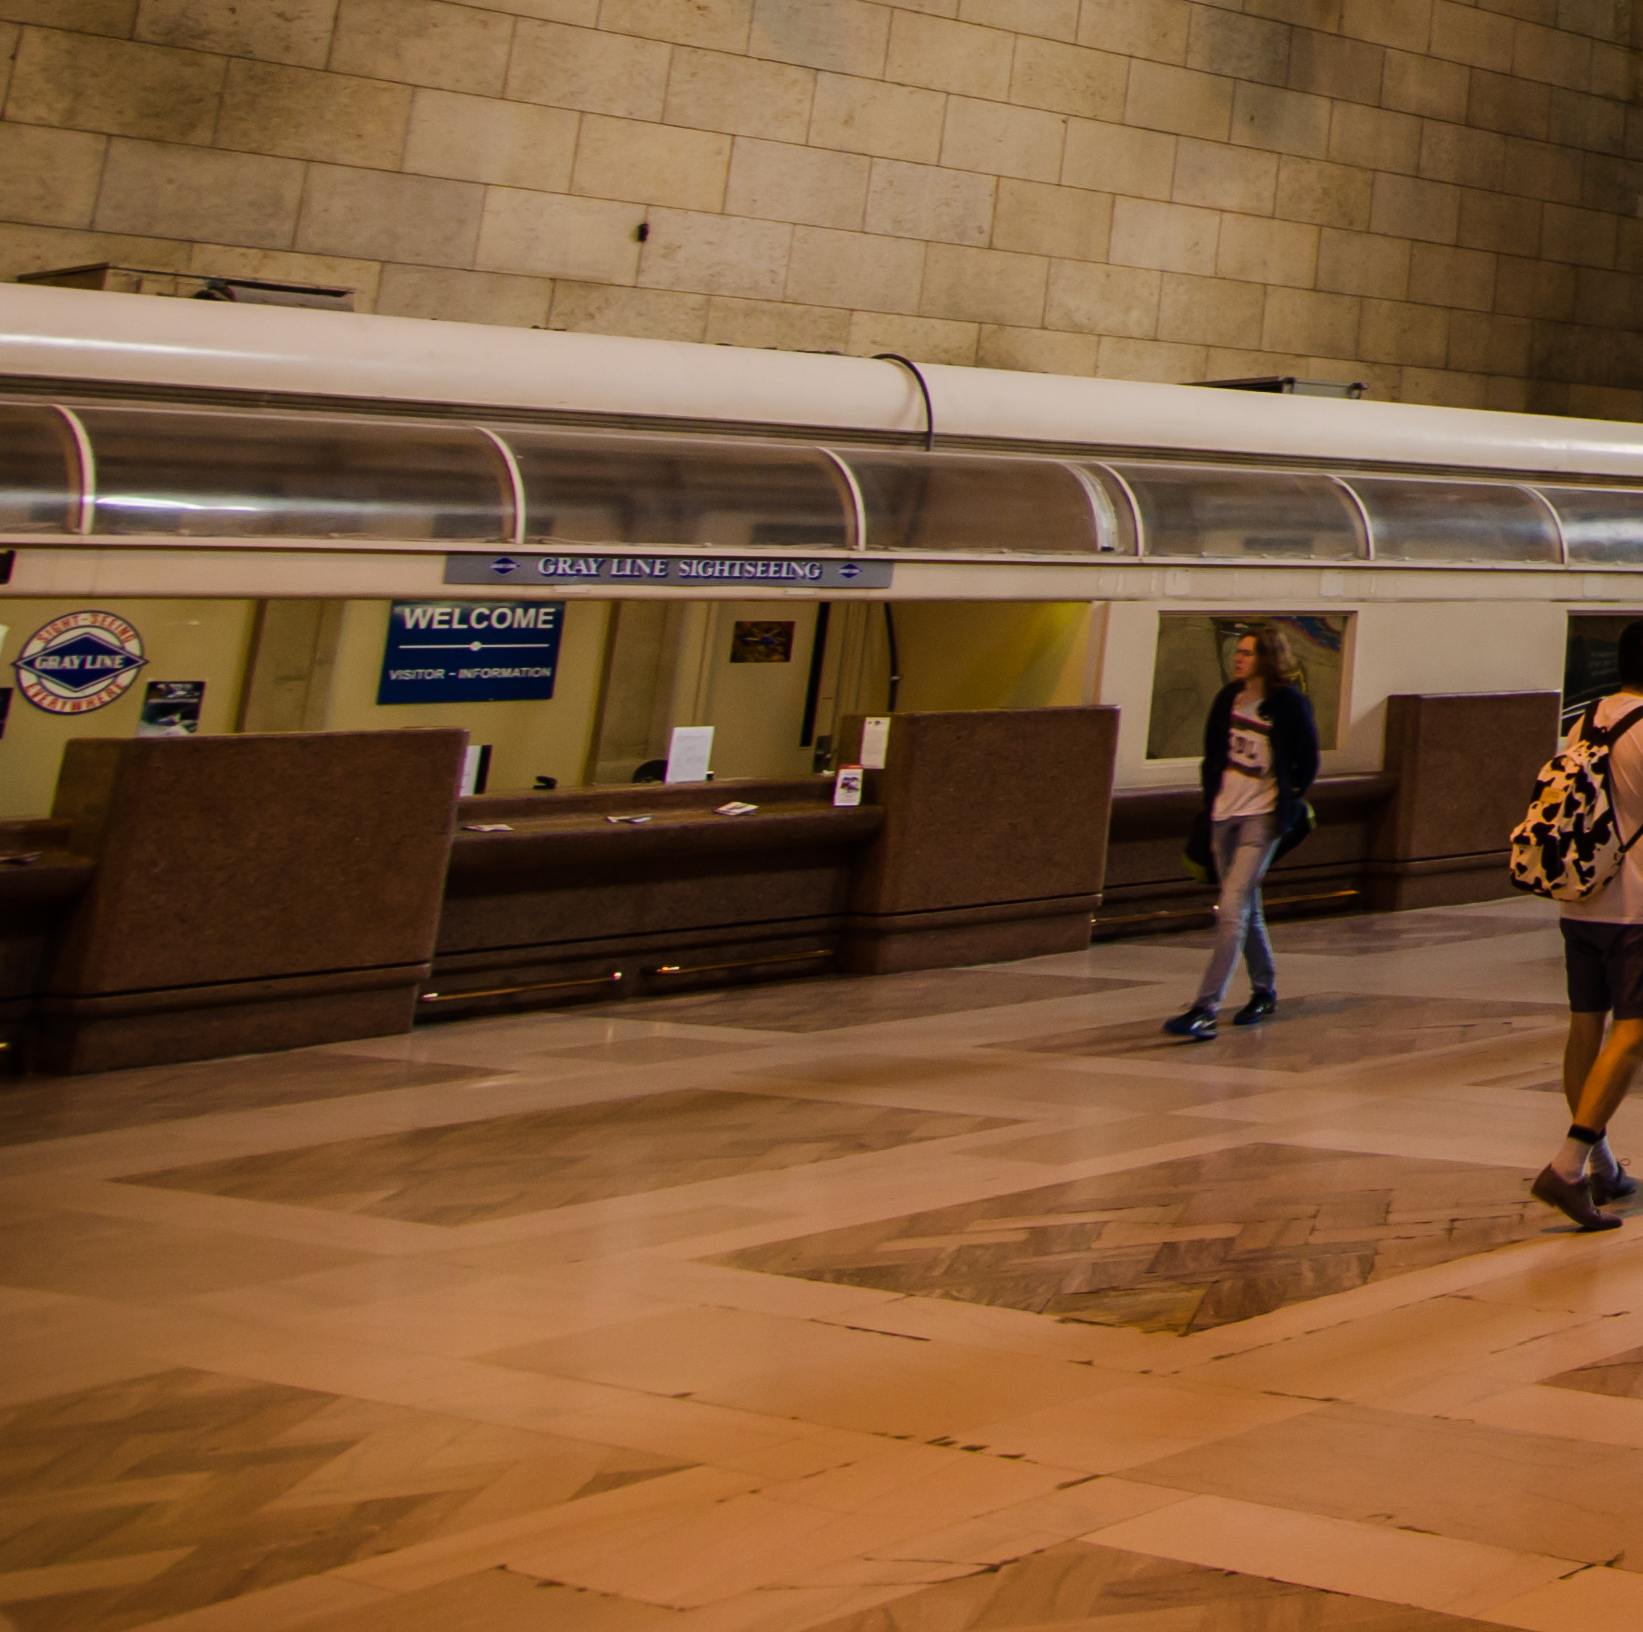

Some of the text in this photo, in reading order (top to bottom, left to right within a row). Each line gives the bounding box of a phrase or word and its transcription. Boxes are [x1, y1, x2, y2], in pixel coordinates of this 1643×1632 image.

[538, 557, 606, 577] GRAY
[610, 558, 669, 577] LINE
[678, 558, 822, 580] SIGHTSEEING
[403, 607, 556, 630] WELCOME
[388, 669, 446, 681] VISITOR
[457, 667, 552, 679] INFORMATION
